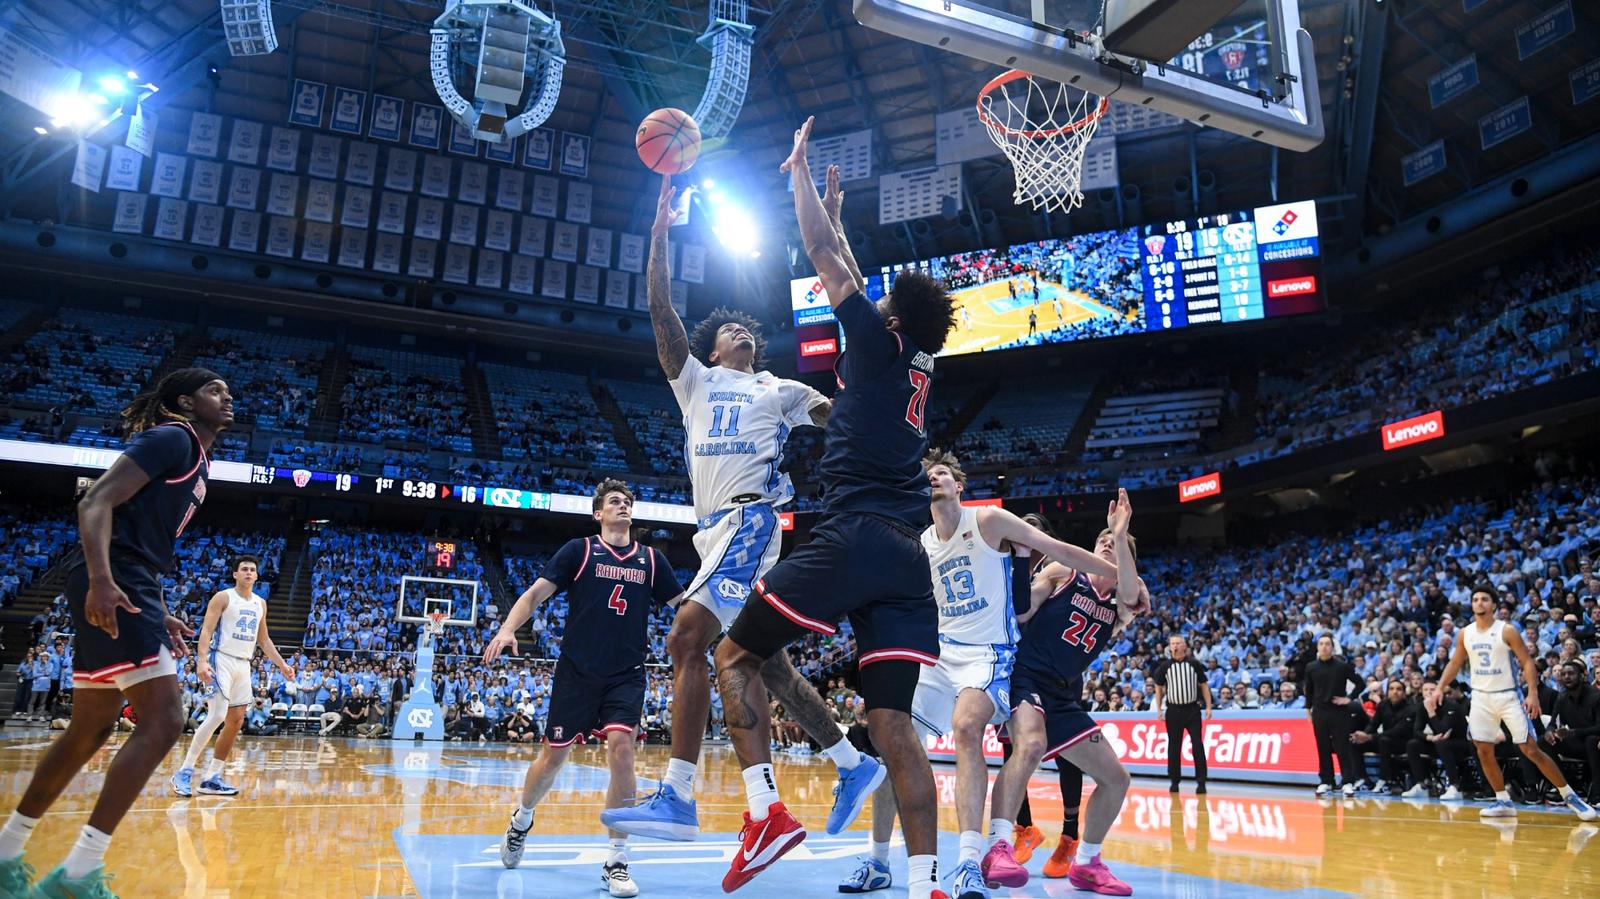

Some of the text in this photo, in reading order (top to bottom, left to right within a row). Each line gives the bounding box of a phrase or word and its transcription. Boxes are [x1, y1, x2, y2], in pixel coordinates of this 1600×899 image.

[1175, 231, 1193, 252] 19
[1264, 246, 1313, 260] CONCESSIONS
[1271, 281, 1312, 294] Lenovo
[804, 343, 833, 353] Lenovo
[708, 391, 754, 404] NORTH
[708, 405, 741, 437] 11
[1387, 420, 1438, 444] Lenovo
[335, 474, 476, 503] 19 1ST 9:38 16
[1182, 479, 1217, 497] Lenovo
[437, 553, 451, 568] 19
[937, 555, 971, 576] NORTH
[596, 563, 646, 584] RADFORD
[941, 569, 976, 603] 13
[608, 584, 627, 615] 4
[941, 597, 988, 617] CAROLINA
[1071, 592, 1116, 625] RADFORD
[235, 616, 257, 634] 44
[1062, 611, 1101, 653] 24
[1478, 652, 1491, 667] 3
[1129, 723, 1281, 764] Stae Farm
